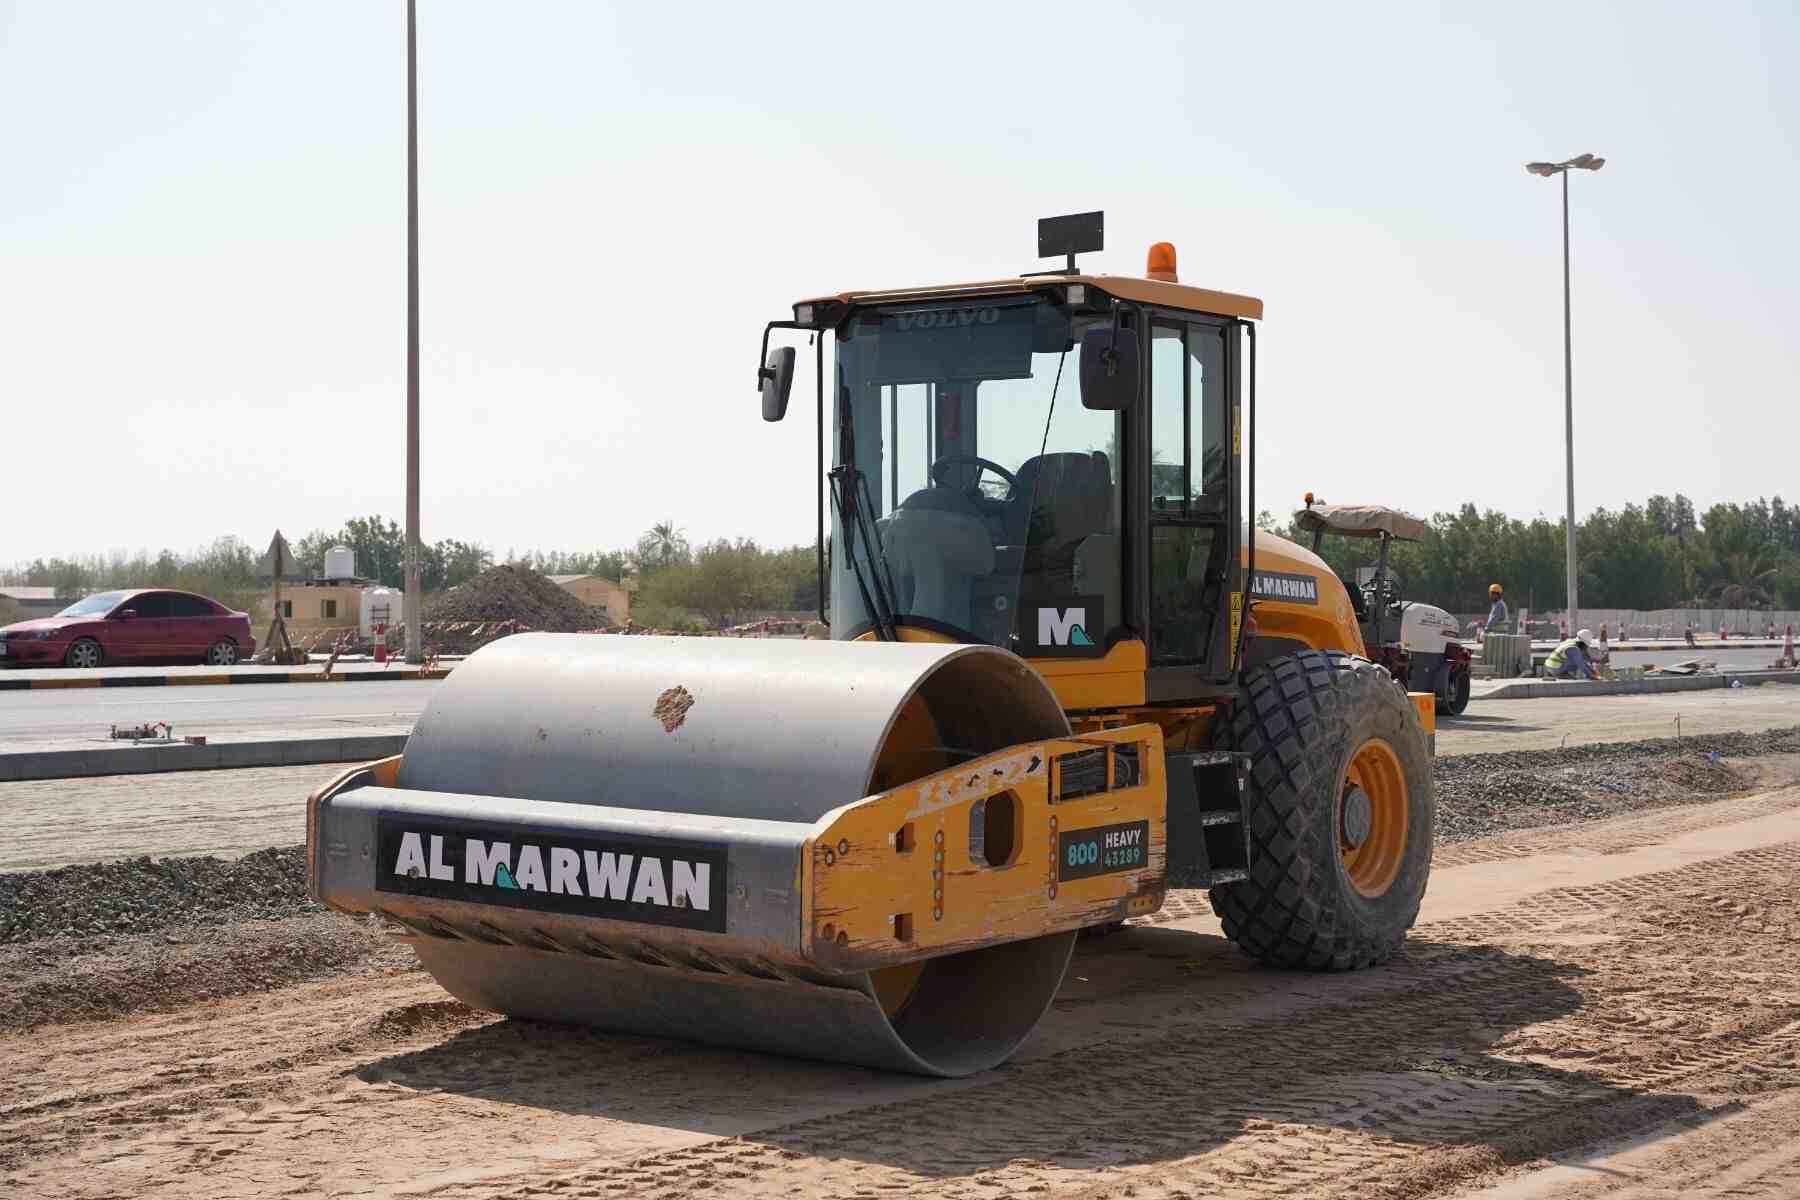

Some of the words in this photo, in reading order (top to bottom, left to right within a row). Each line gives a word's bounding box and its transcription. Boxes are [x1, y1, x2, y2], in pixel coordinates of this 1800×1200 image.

[895, 308, 1000, 331] VOLVO
[1263, 577, 1316, 599] MARWAN
[1105, 829, 1142, 849] HEAVY
[1067, 841, 1098, 866] 800
[394, 831, 455, 882] AL
[465, 838, 711, 912] MARWAN
